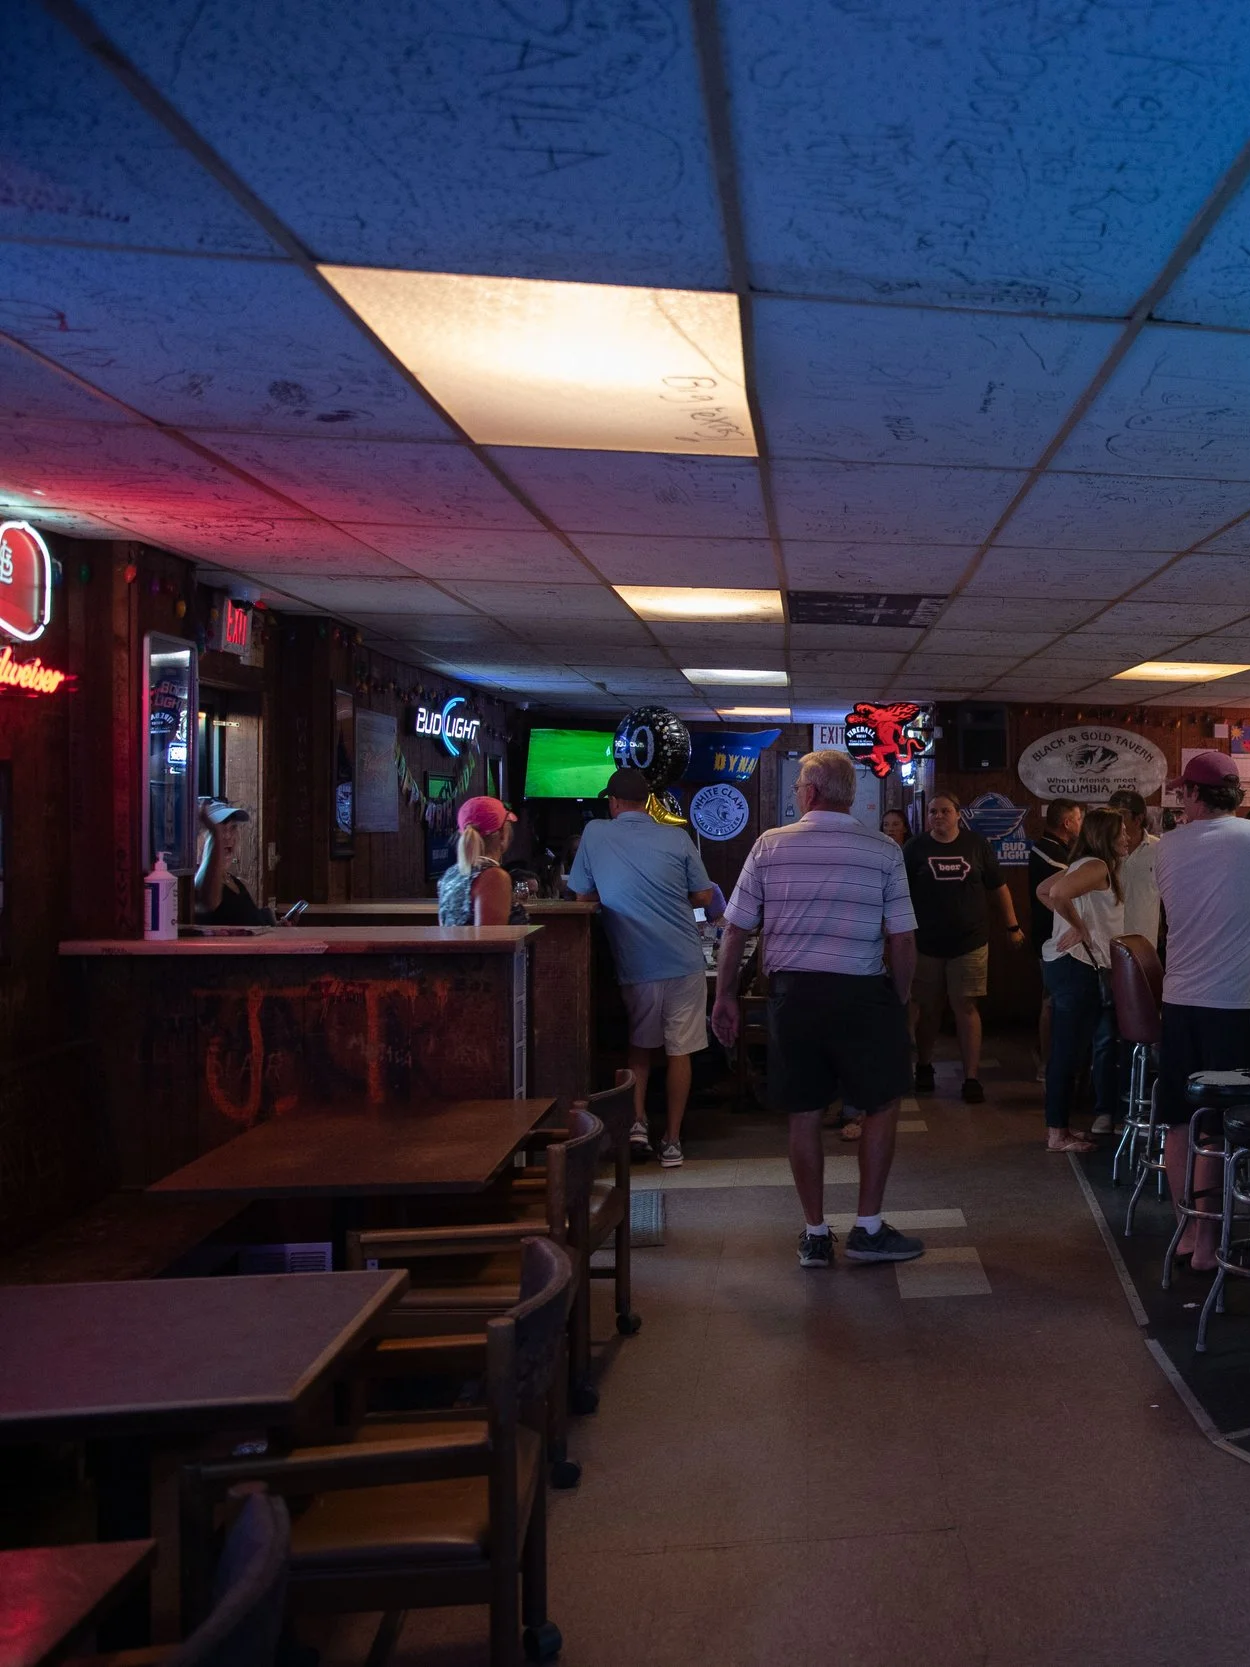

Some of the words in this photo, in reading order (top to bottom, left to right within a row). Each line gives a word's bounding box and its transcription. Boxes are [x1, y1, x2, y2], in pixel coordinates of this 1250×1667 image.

[416, 708, 442, 734] BUD
[446, 719, 480, 741] LIGHT
[846, 726, 876, 739] FIREBALL
[820, 726, 846, 744] EXIT
[1032, 738, 1065, 762] BLACK
[1081, 731, 1112, 742] GOLD
[1116, 735, 1154, 763] TAVERN
[694, 787, 719, 810] WHITE
[721, 787, 745, 811] CLAW
[697, 816, 713, 833] HARD
[715, 816, 740, 834] SELTZER
[997, 850, 1031, 860] LIGHT
[1002, 842, 1026, 852] BUD
[938, 863, 961, 871] beer
